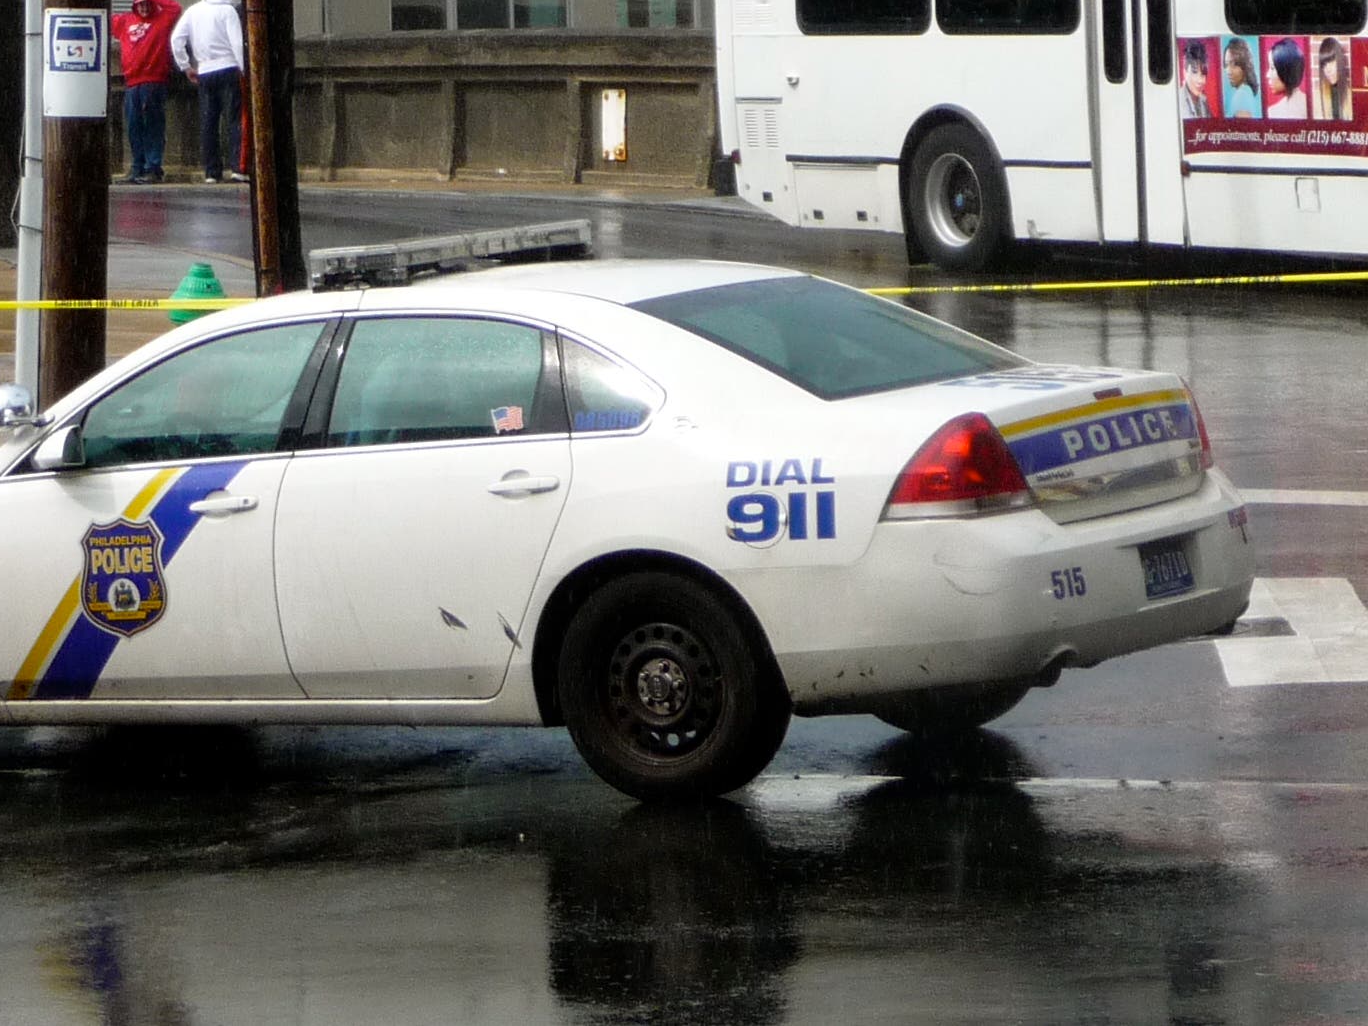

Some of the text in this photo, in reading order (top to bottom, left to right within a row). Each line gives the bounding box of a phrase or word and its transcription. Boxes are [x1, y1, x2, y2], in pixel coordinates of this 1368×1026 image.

[1264, 130, 1289, 145] please
[1290, 130, 1306, 143] call
[1307, 130, 1330, 146] (215)
[1060, 409, 1178, 460] POLICE
[726, 458, 835, 488] DIAL
[726, 491, 836, 543] 911
[89, 535, 152, 546] PHILADELPHIA
[91, 546, 153, 574] POLICE
[1051, 566, 1087, 600] 515
